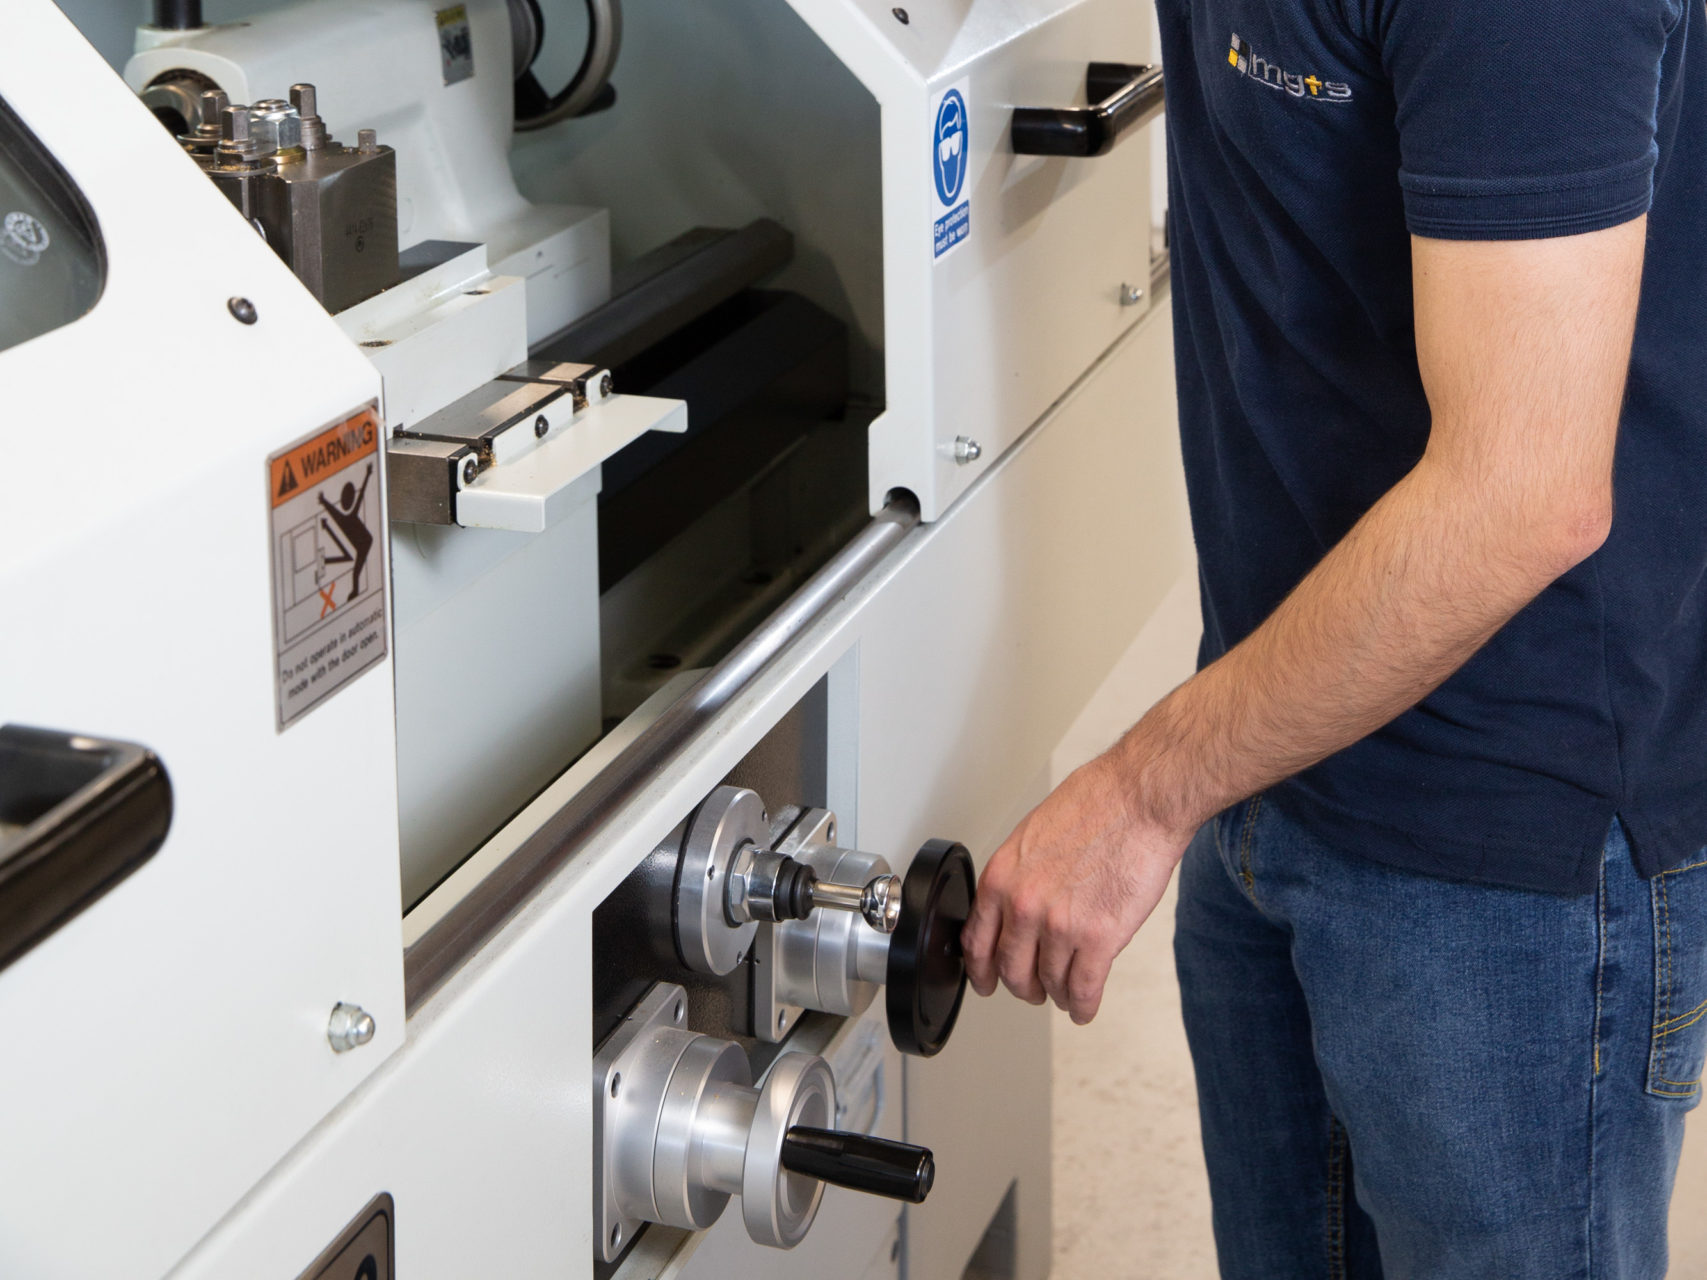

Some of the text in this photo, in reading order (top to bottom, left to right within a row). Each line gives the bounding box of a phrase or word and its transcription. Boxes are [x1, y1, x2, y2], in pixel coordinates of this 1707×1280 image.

[935, 206, 969, 238] Eye protection
[935, 223, 968, 253] must be worn
[301, 422, 373, 478] WARNING
